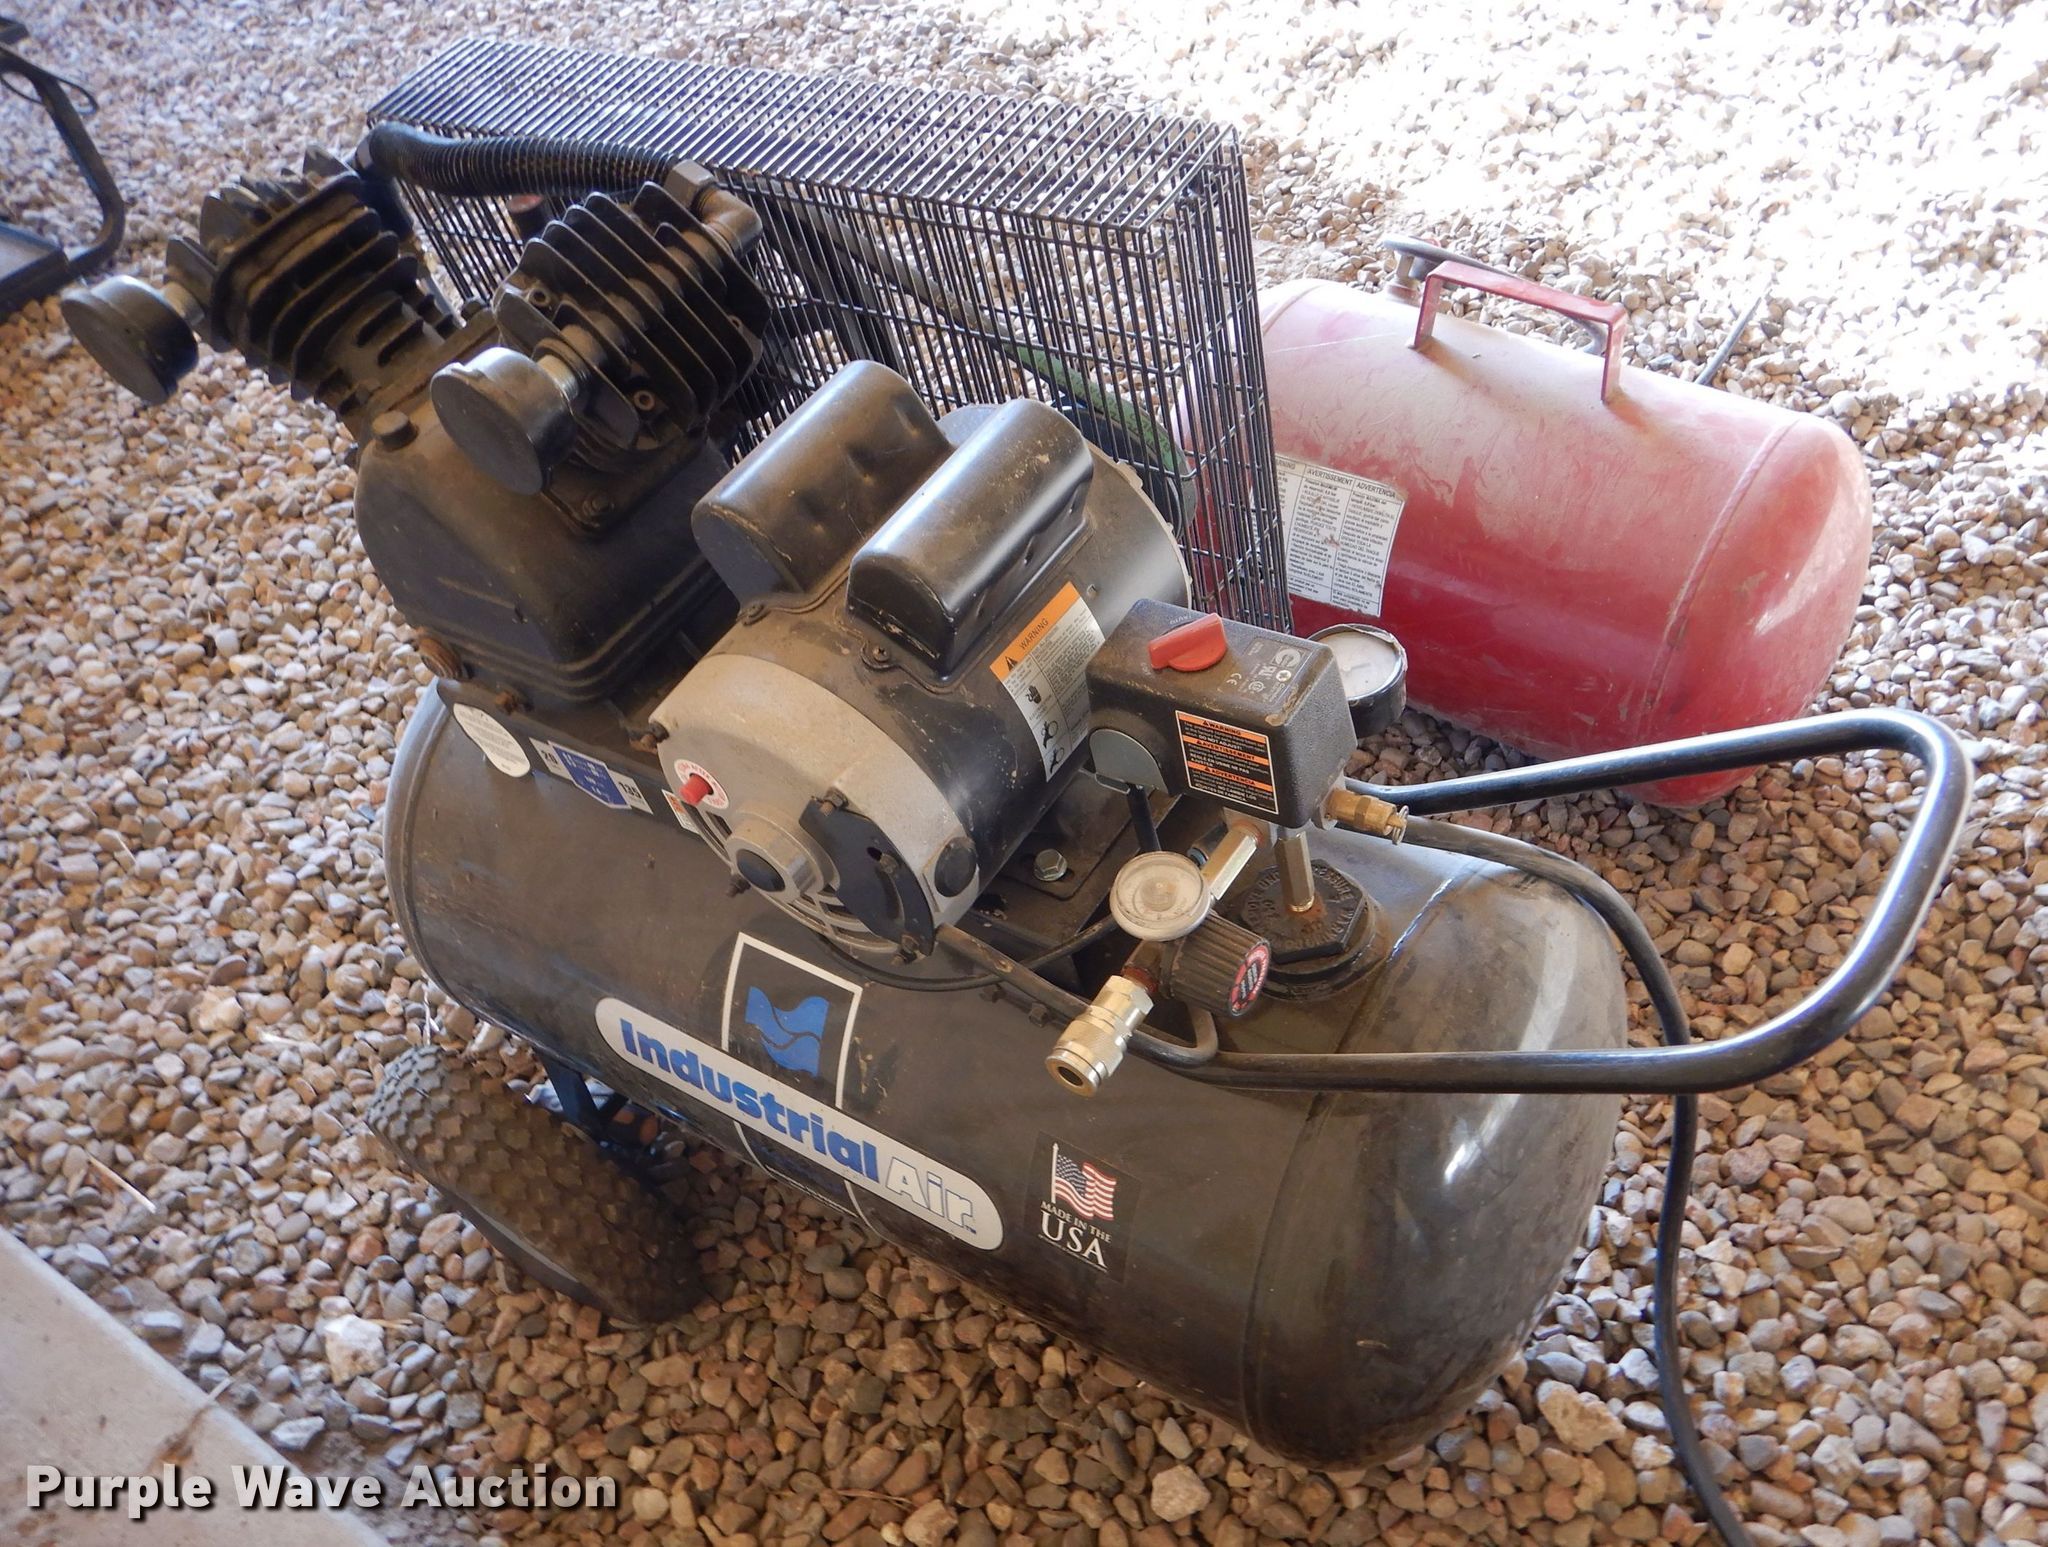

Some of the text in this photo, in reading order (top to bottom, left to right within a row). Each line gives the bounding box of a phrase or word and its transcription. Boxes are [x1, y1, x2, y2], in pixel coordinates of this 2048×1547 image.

[1019, 617, 1049, 650] WARNING
[1210, 721, 1242, 736] WARNING
[1203, 741, 1255, 760] AVERTISSEMENT
[1212, 769, 1256, 785] ADVERTENCIA
[620, 1018, 879, 1183] Industrial
[886, 1157, 973, 1228] Air
[1040, 1201, 1112, 1244] MADE IN THE
[1041, 1209, 1108, 1268] USA
